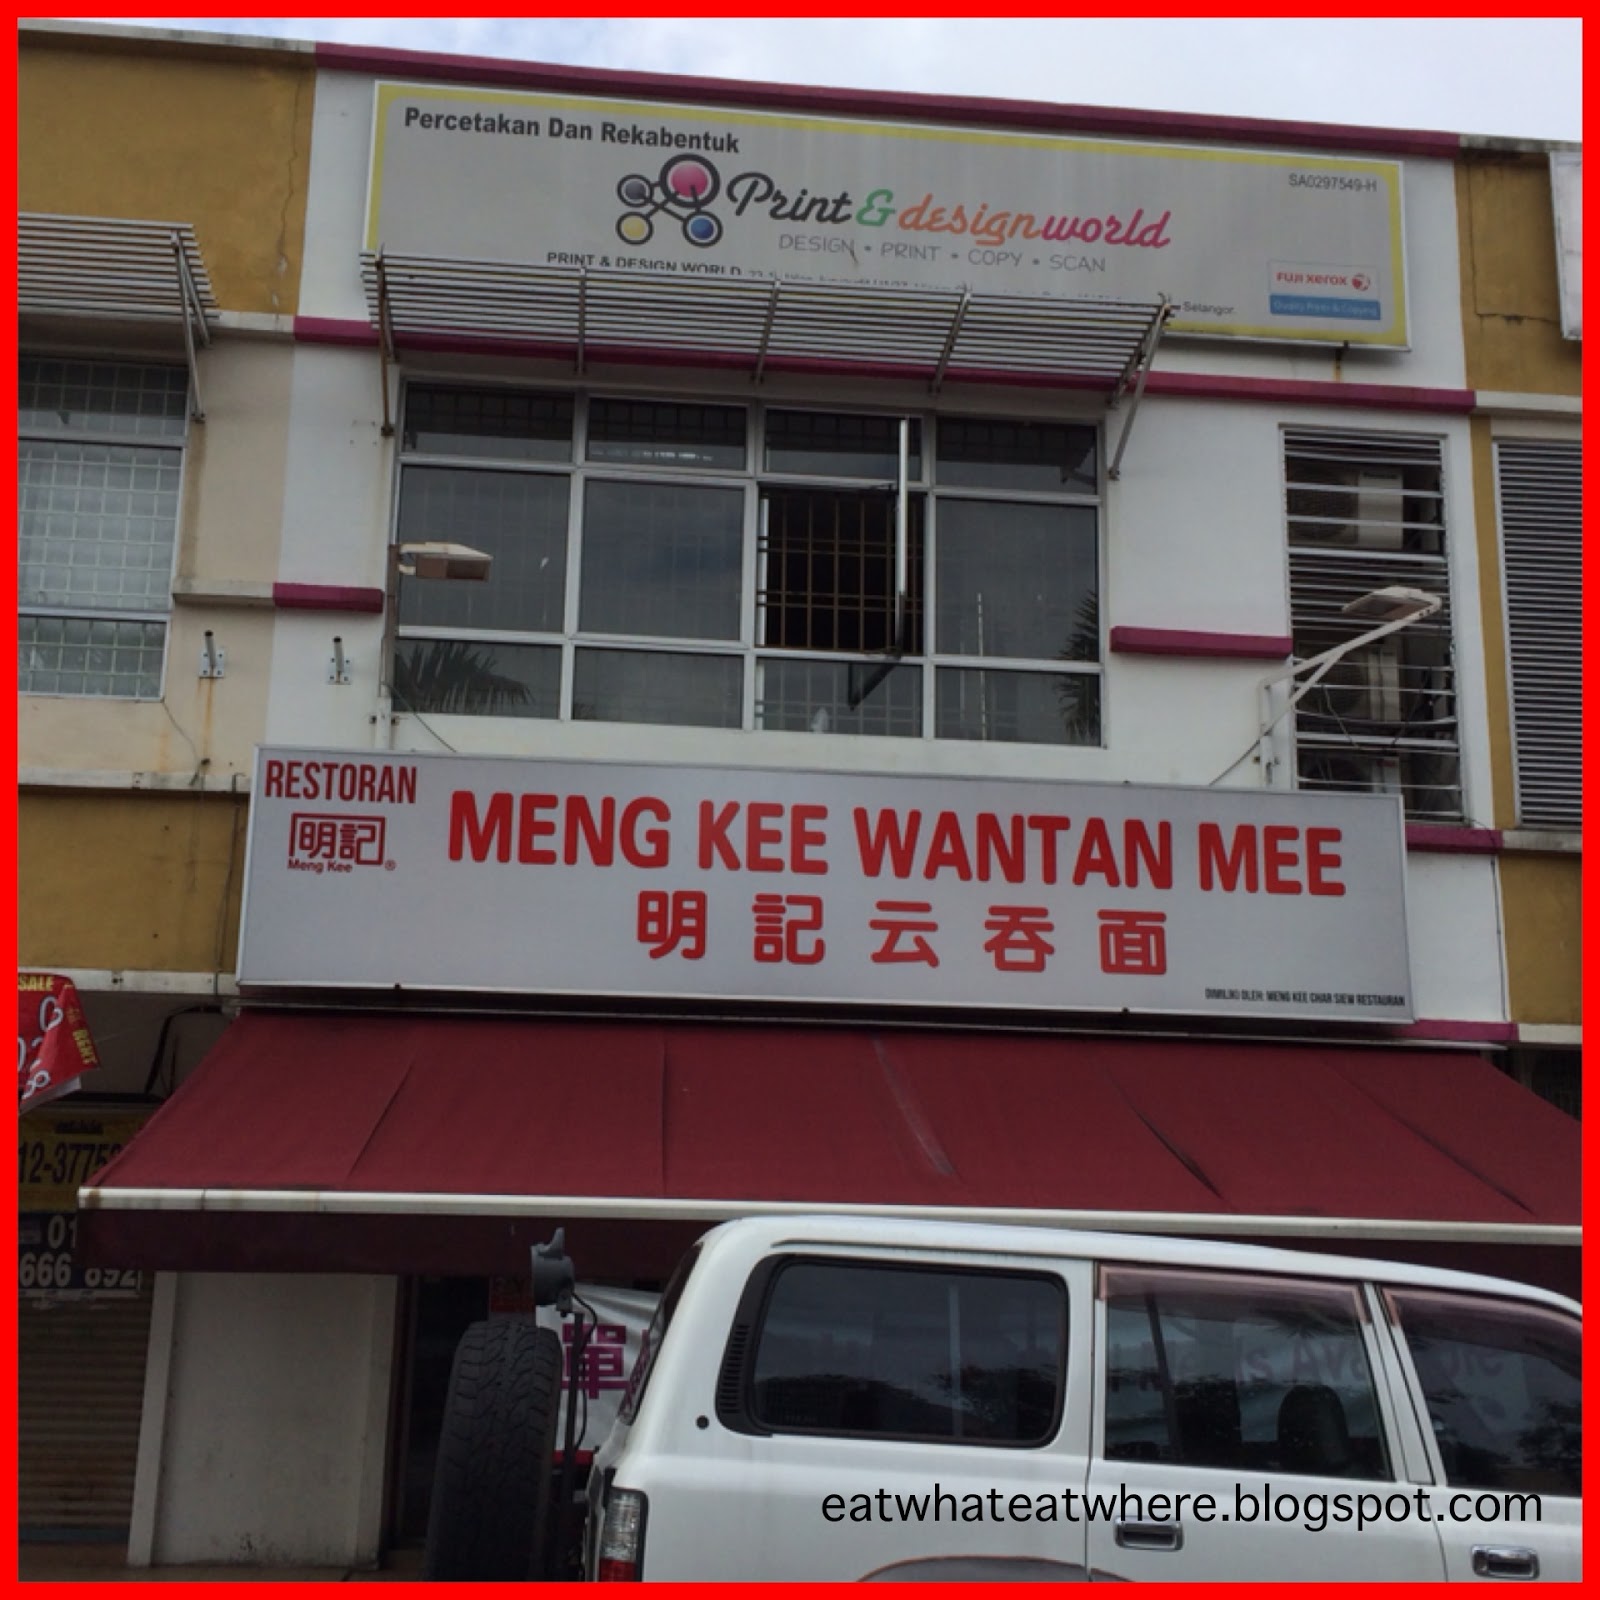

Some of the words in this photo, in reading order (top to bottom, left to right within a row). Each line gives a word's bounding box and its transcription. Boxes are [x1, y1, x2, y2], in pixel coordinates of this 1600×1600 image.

[404, 107, 540, 137] Percetakan
[548, 117, 592, 141] Dan
[601, 122, 740, 153] Rekabentuk
[726, 172, 852, 226] Print
[855, 188, 894, 227] &
[1288, 172, 1377, 192] SA0297549-H
[546, 252, 595, 267] PRINT
[778, 233, 857, 256] DESIGN
[880, 242, 940, 261] PRINT
[968, 248, 1023, 267] COPY
[1049, 254, 1106, 273] SCAN
[264, 760, 417, 804] RESTORAN
[448, 790, 671, 869] MENG
[698, 799, 829, 876] KEE
[852, 806, 1174, 890] WANTAN
[1197, 822, 1347, 897] MEE
[287, 858, 323, 874] Meng
[327, 860, 352, 873] Kee
